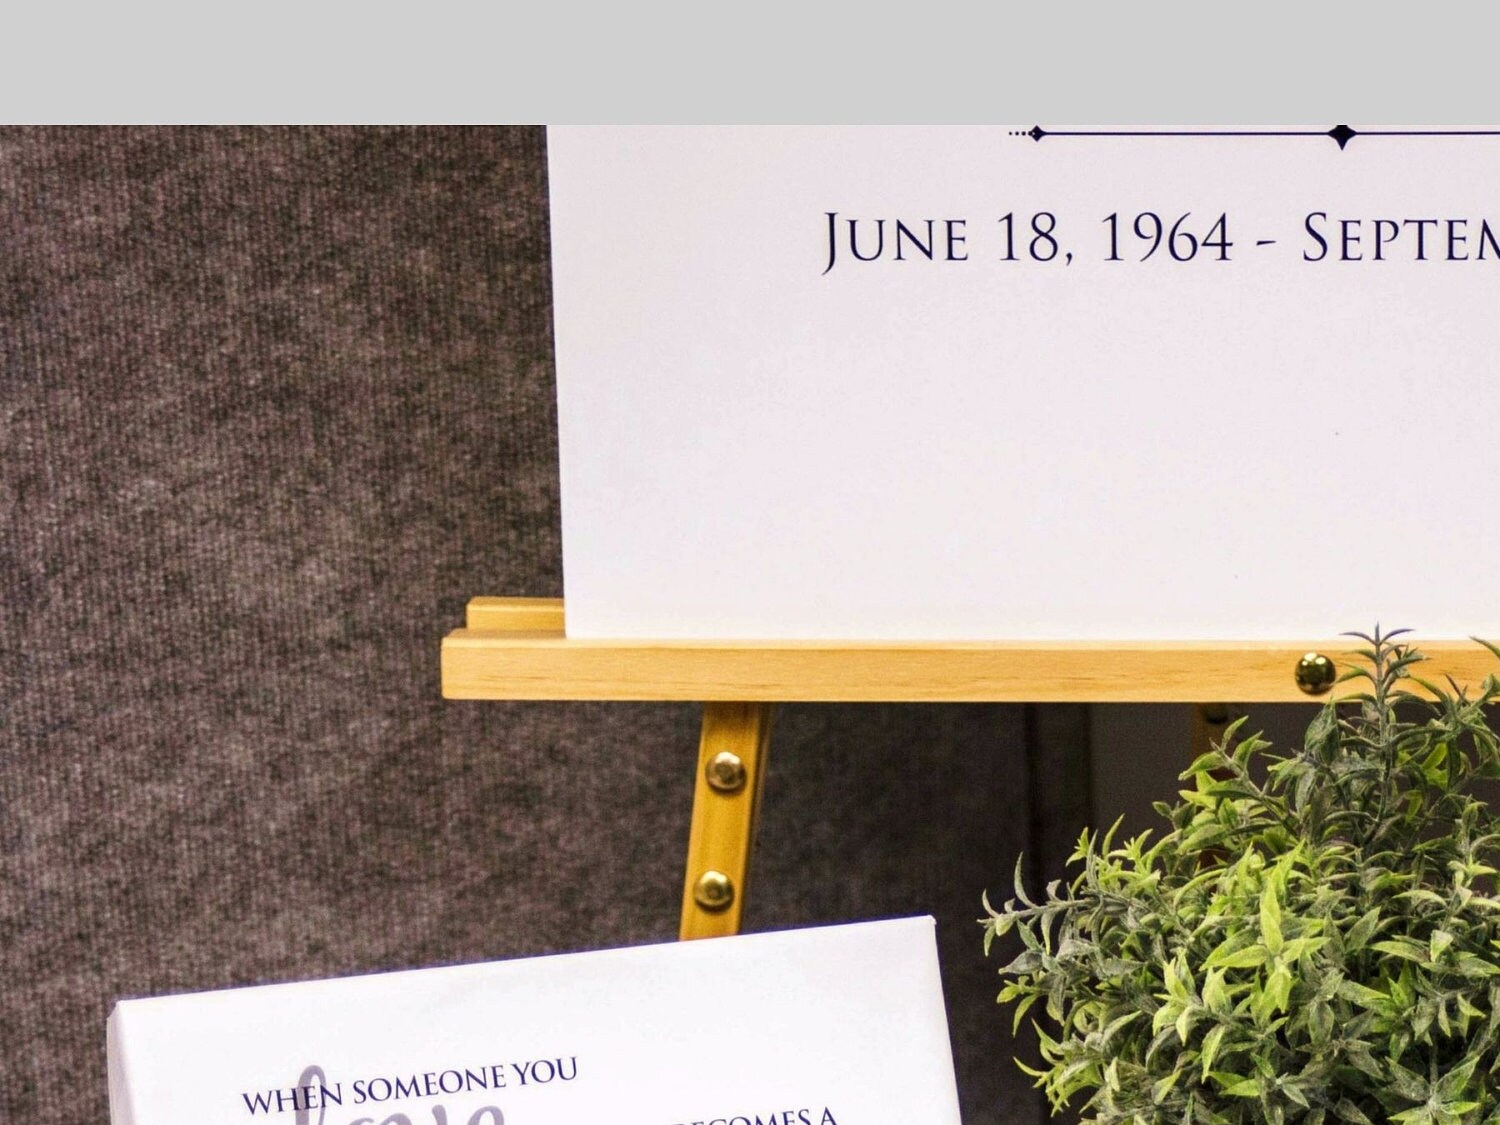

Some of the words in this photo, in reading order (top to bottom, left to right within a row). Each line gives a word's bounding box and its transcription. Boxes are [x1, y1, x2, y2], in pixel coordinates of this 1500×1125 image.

[819, 211, 971, 277] JUNE
[995, 211, 1077, 268] 18,
[1102, 211, 1234, 263] 1964
[242, 1082, 344, 1117] WHEN
[352, 1064, 507, 1105] SOMEONE
[511, 1056, 579, 1086] YOU
